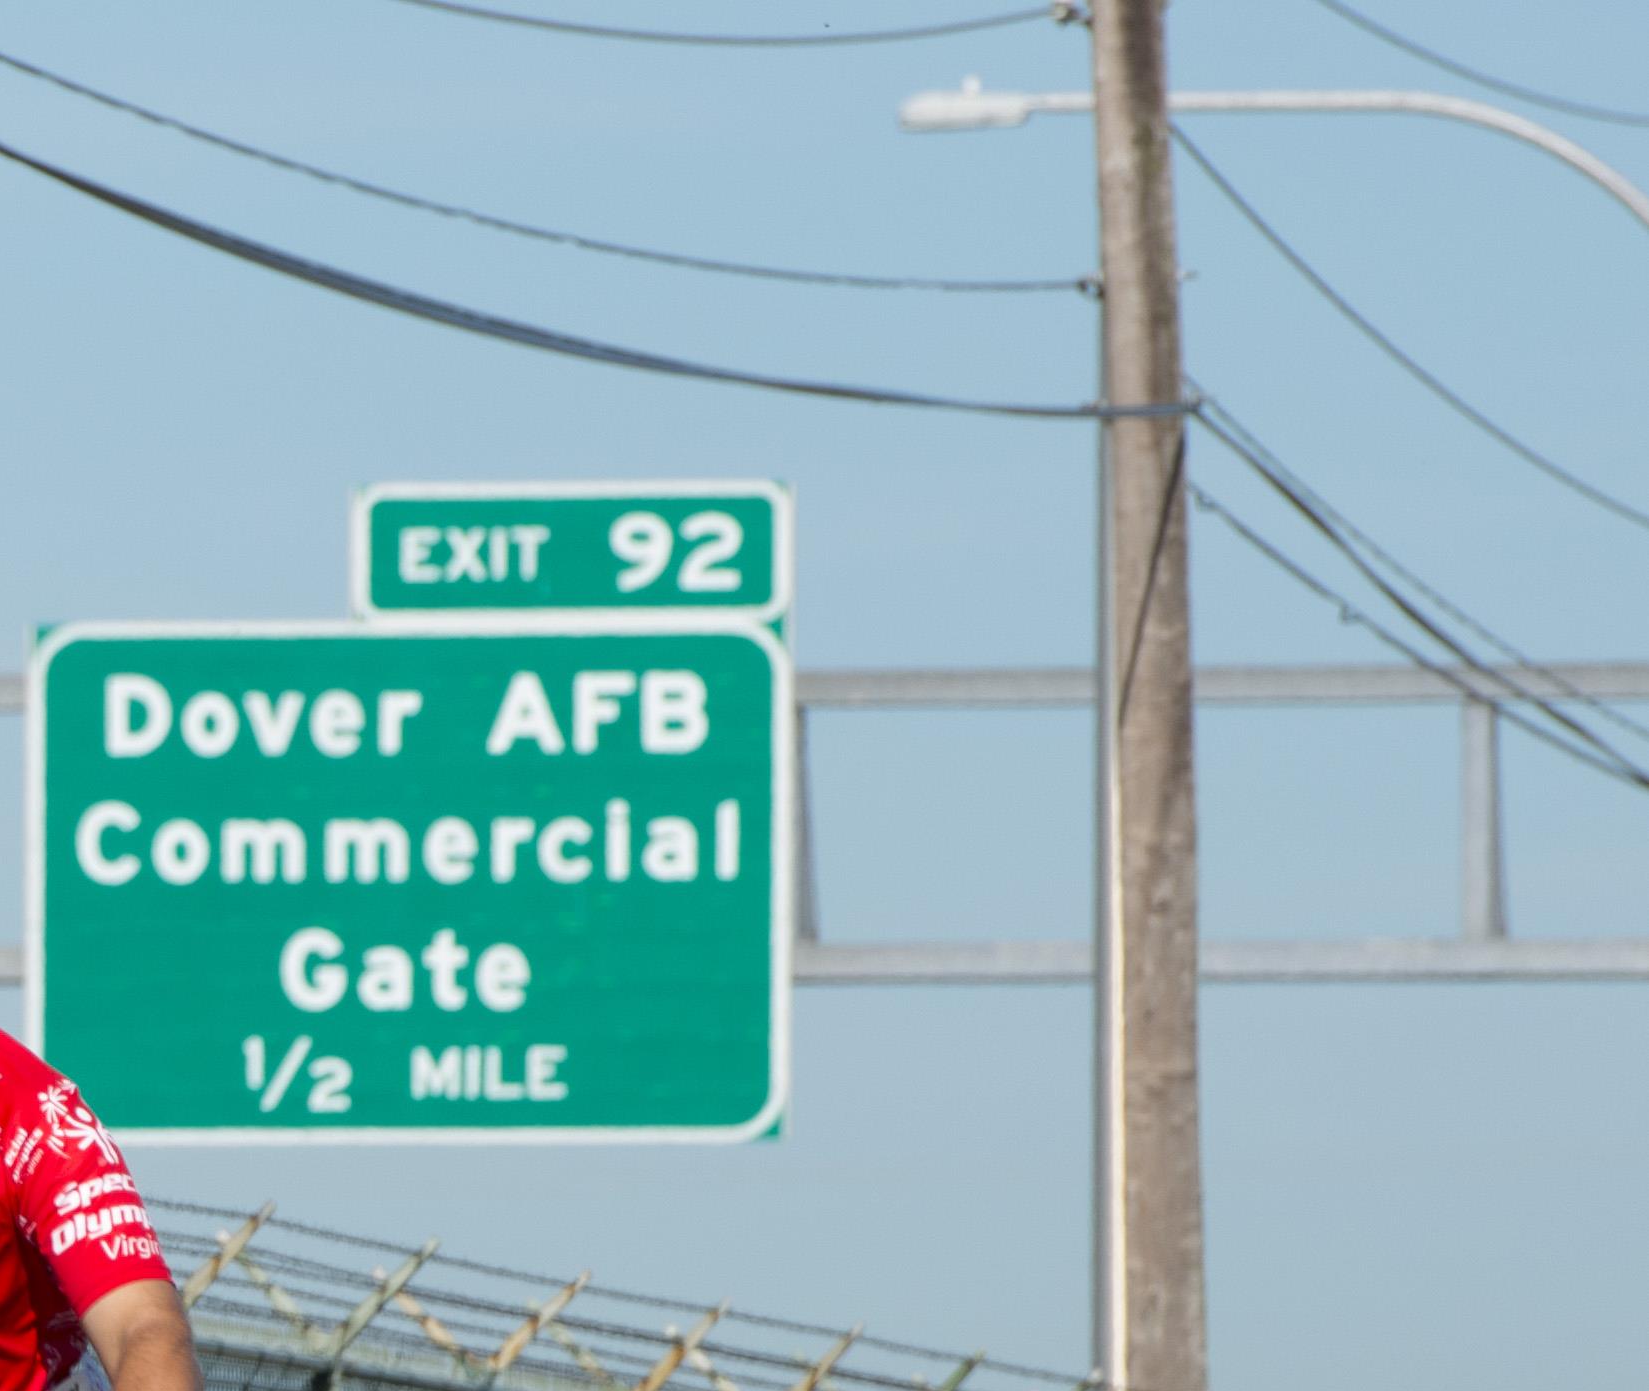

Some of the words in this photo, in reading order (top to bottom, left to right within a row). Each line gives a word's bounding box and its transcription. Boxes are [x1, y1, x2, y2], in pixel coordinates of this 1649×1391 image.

[398, 524, 550, 584] EXIT
[608, 510, 744, 593] 92
[103, 672, 423, 759] Dover
[486, 668, 710, 756] AFB
[74, 798, 741, 886] Commercial
[279, 926, 532, 1013] Gate
[243, 1035, 353, 1114] 1/2
[409, 1043, 568, 1101] MILE
